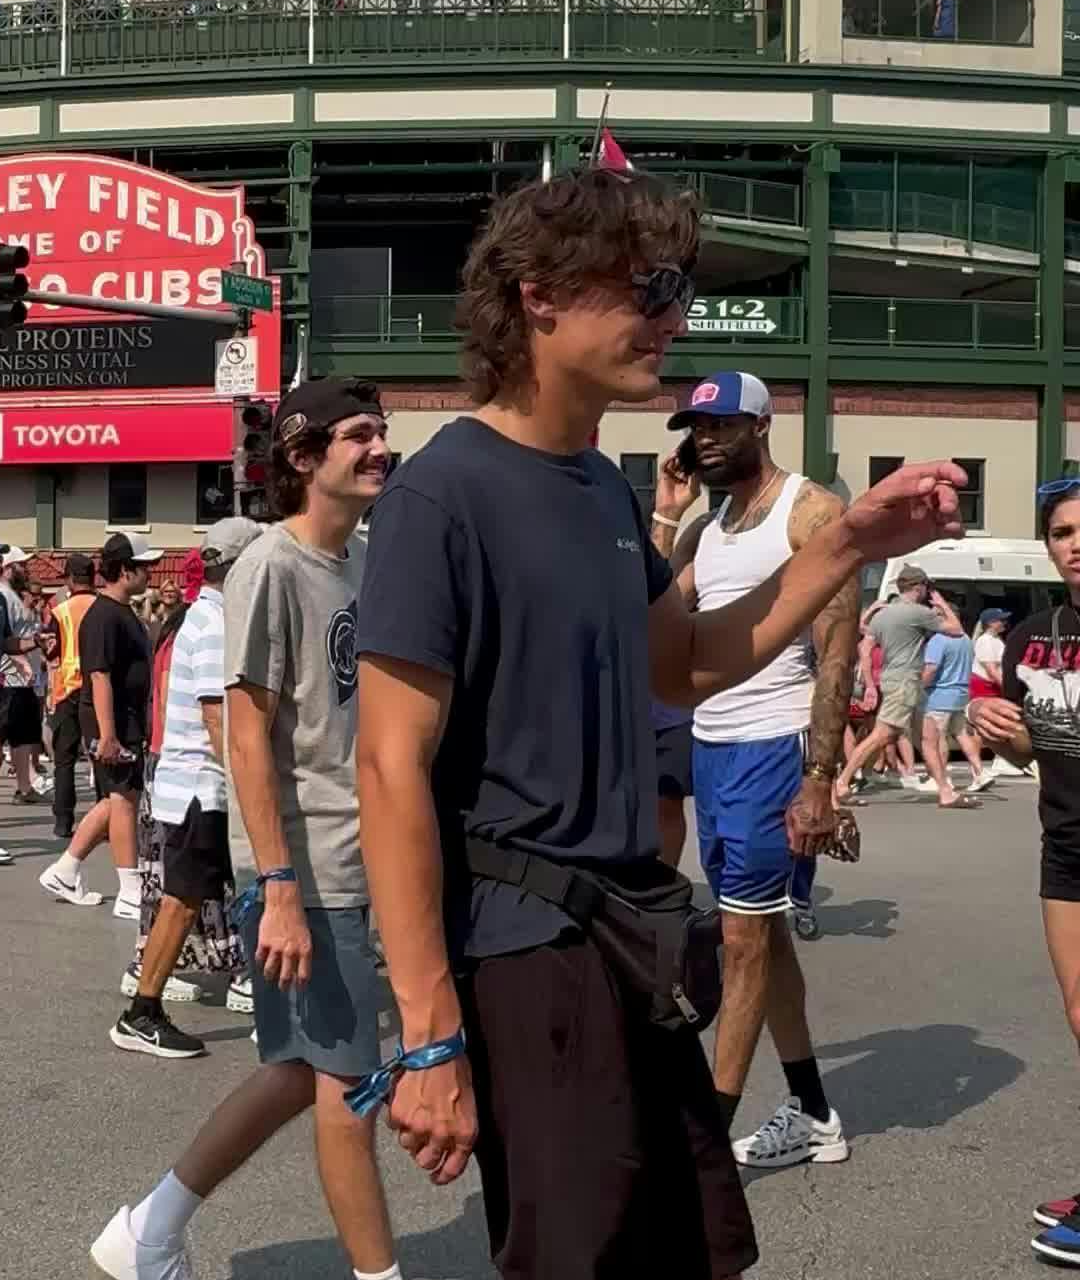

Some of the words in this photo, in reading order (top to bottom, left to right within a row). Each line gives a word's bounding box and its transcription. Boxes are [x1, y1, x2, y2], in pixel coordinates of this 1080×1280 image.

[88, 174, 225, 246] FIELD
[79, 229, 123, 253] OF
[91, 267, 222, 306] CUBS
[17, 326, 153, 351] PROTEINS
[55, 353, 71, 369] IS
[76, 351, 137, 369] VITAL
[13, 424, 120, 446] TOYOTA
